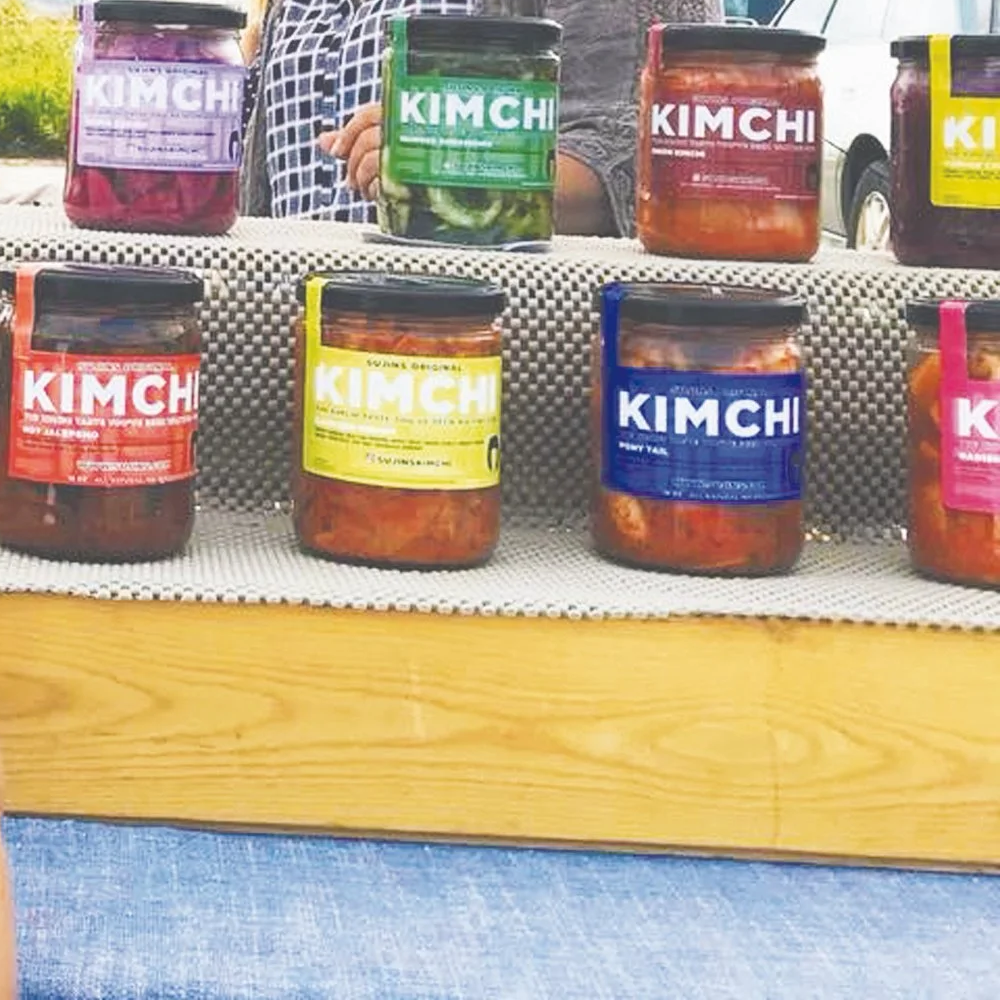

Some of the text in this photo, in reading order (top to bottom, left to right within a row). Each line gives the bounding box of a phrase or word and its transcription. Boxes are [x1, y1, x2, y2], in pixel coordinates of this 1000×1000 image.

[85, 74, 239, 113] KIMCHI
[401, 91, 554, 131] KIMCHI
[652, 103, 816, 143] KIMCHI
[23, 370, 199, 416] KIMCHI
[315, 366, 497, 415] KIMCHI
[618, 390, 800, 438] KIMCHI
